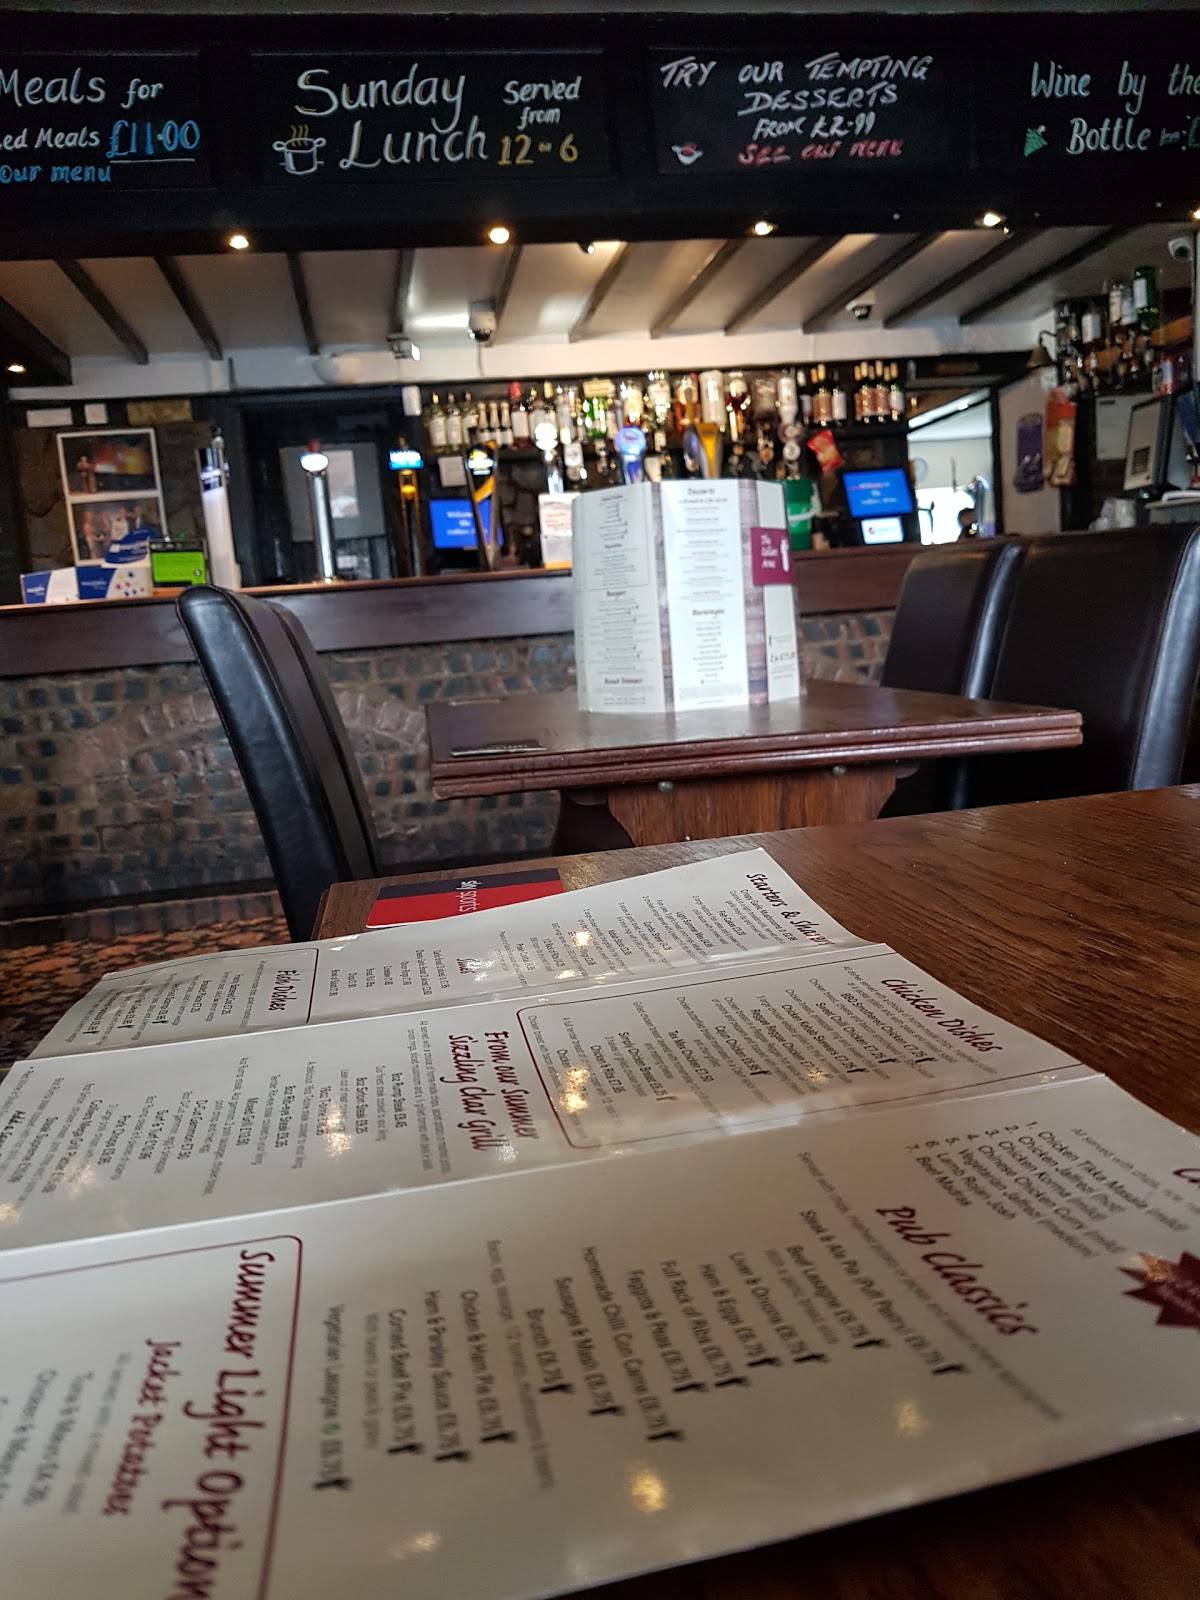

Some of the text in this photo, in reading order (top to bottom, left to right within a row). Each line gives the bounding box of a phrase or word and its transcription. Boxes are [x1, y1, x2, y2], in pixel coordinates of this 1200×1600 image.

[0, 67, 164, 109] Meals for
[503, 75, 582, 105] Served
[660, 52, 934, 88] TRY OUR TEMPTING
[1031, 60, 1200, 115] Wine by the
[294, 63, 466, 134] Sunday
[516, 106, 560, 130] from
[737, 81, 898, 116] DESSERTS
[0, 127, 28, 150] ed
[35, 126, 100, 149] Meals
[338, 116, 487, 170] Lunch
[752, 117, 806, 140] FROM
[1066, 117, 1151, 155] Bottle
[497, 134, 535, 165] 12
[560, 133, 578, 162] 6
[738, 143, 791, 165] SEE
[51, 165, 112, 183] menu
[746, 872, 789, 908] Starters
[781, 906, 801, 919] &
[269, 969, 300, 1011] Fish Dishes
[881, 978, 1003, 1053] Chicken Dishes
[440, 1034, 505, 1152] Sizzling Char Grill
[485, 1030, 540, 1141] From our Summer
[999, 1141, 1037, 1171] Chicken
[1019, 1136, 1057, 1166] Chicken
[1039, 1132, 1078, 1160] Chicken
[876, 1206, 1038, 1336] Pub Classics
[223, 1249, 275, 1359] Summer
[102, 1338, 182, 1516] Jacket Potatoes
[182, 1369, 267, 1459] Light
